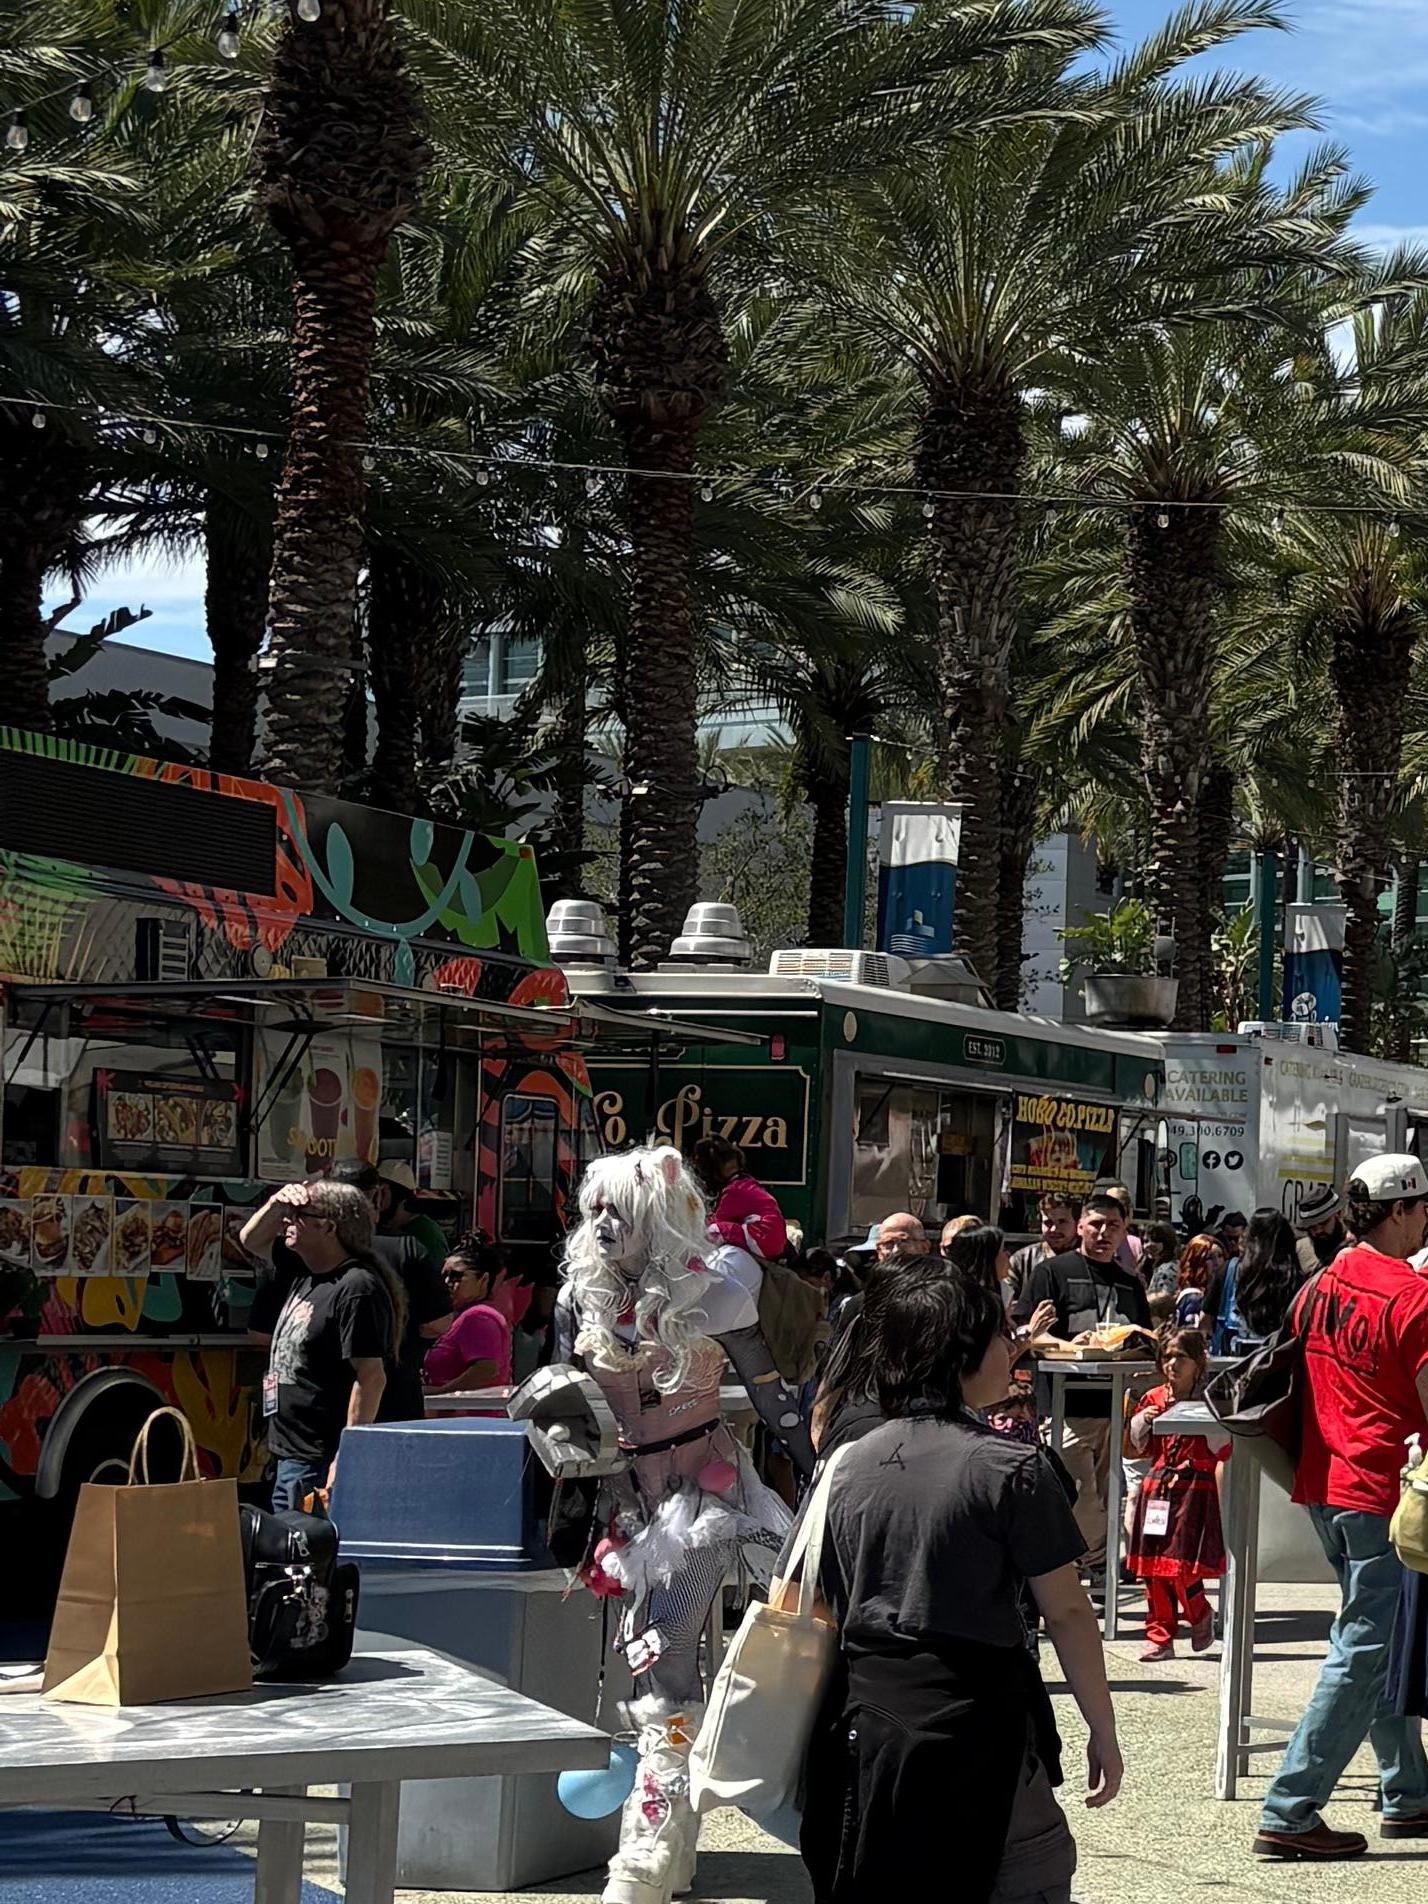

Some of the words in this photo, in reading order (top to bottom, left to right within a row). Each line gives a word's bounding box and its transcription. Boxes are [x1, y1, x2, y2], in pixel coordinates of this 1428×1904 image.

[1167, 1070, 1247, 1086] CATERING
[1166, 1087, 1248, 1103] AVAILABLE
[655, 1083, 788, 1150] Pizza
